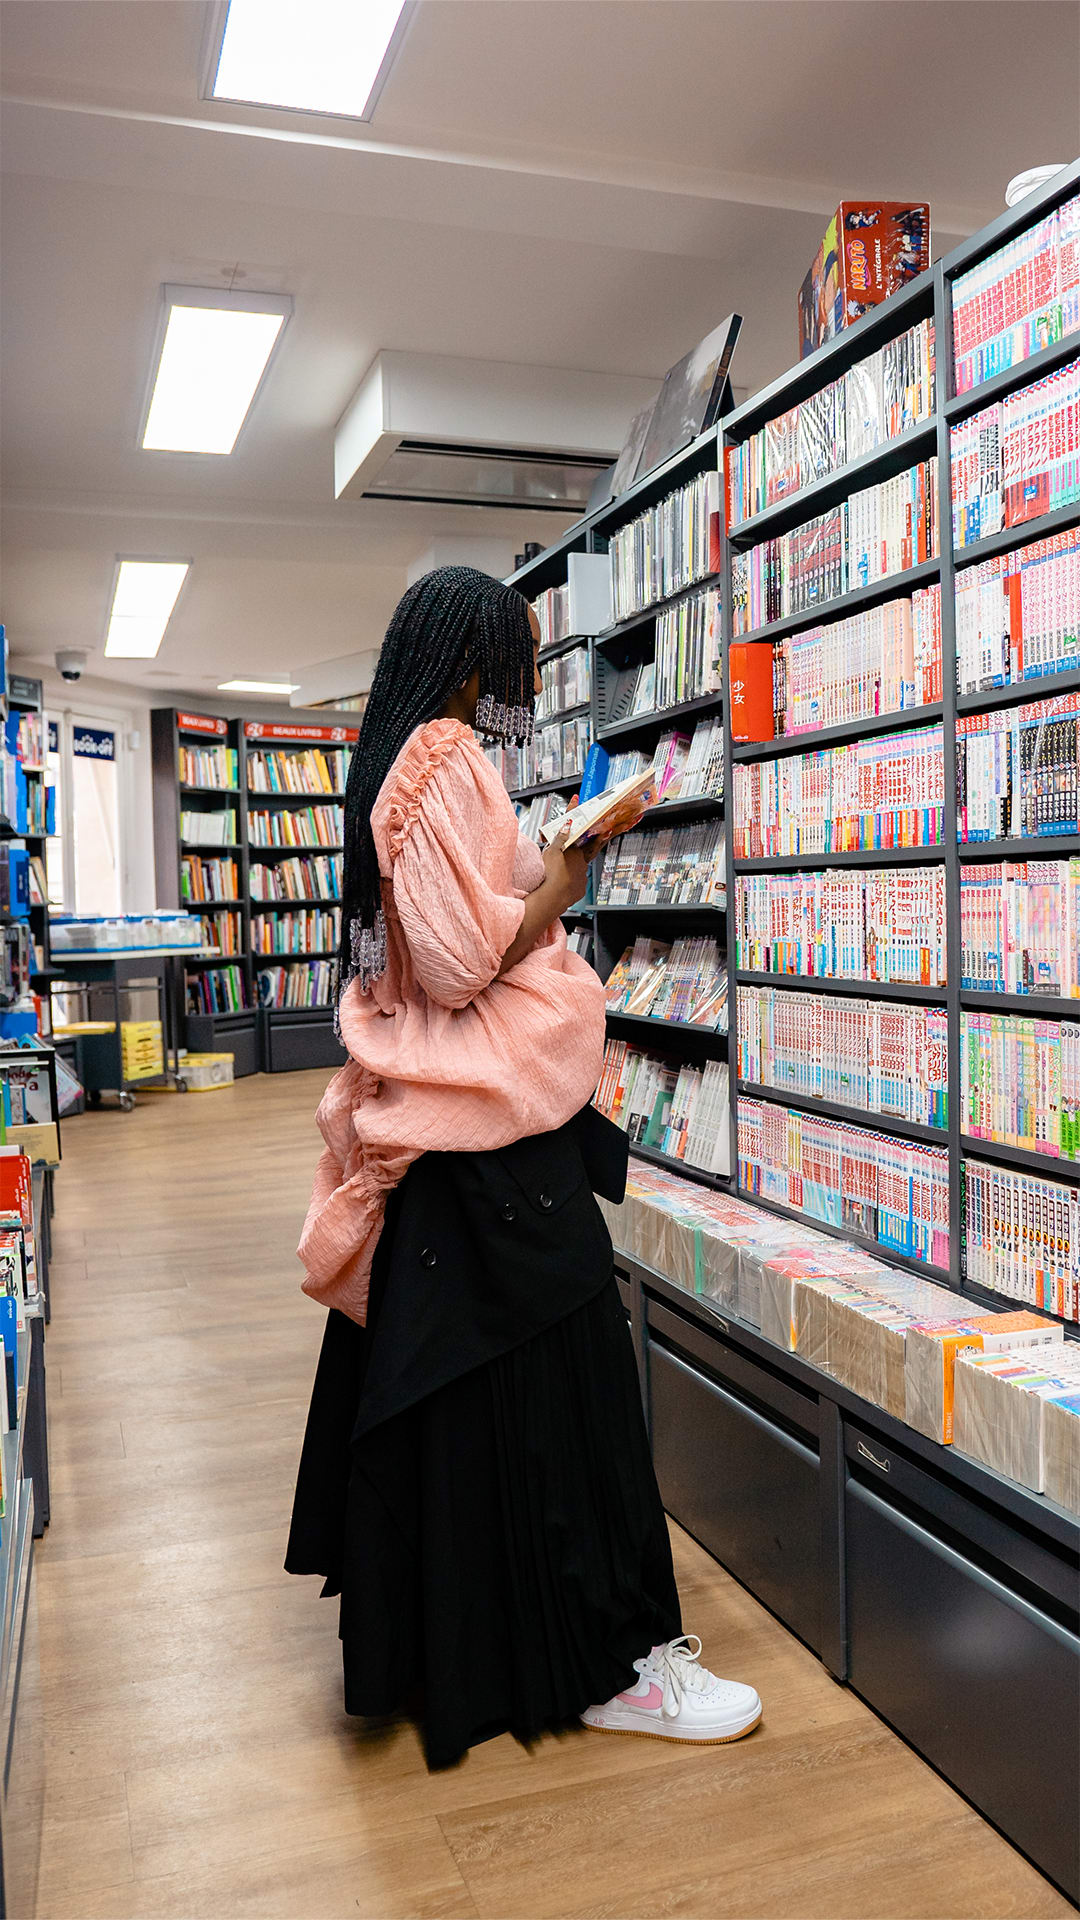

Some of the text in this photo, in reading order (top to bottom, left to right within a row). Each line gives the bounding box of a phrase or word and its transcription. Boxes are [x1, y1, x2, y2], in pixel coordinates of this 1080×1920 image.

[850, 239, 867, 291] NARUTO
[874, 238, 883, 290] L'INTÉGRALE
[733, 680, 745, 705] 少女
[272, 726, 296, 736] BEAUX
[297, 727, 322, 737] LIVRES
[582, 747, 600, 803] angas Japonais
[971, 1234, 977, 1246] 2
[976, 1234, 982, 1246] 3
[986, 1238, 992, 1251] 5
[592, 1717, 606, 1727] AIR
